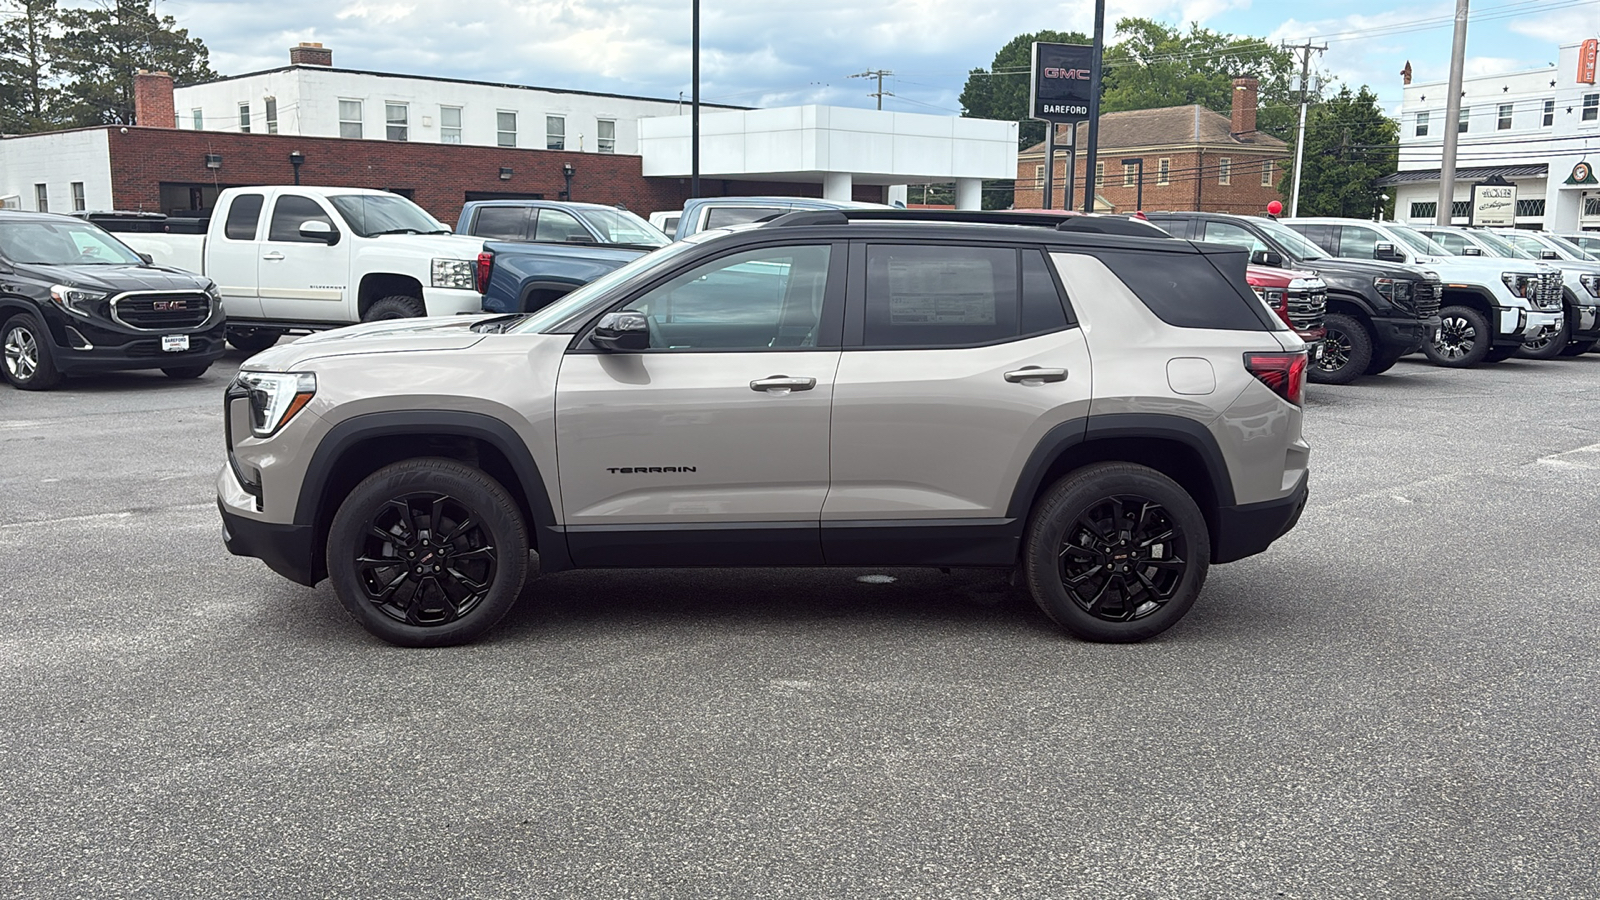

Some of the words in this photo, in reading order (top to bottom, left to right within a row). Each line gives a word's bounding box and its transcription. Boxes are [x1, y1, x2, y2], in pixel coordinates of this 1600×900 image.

[1586, 42, 1595, 80] ACME
[1044, 67, 1090, 80] GMC
[1043, 104, 1087, 115] BAREFORD
[153, 300, 187, 310] GMC
[606, 466, 697, 474] TERRAIN
